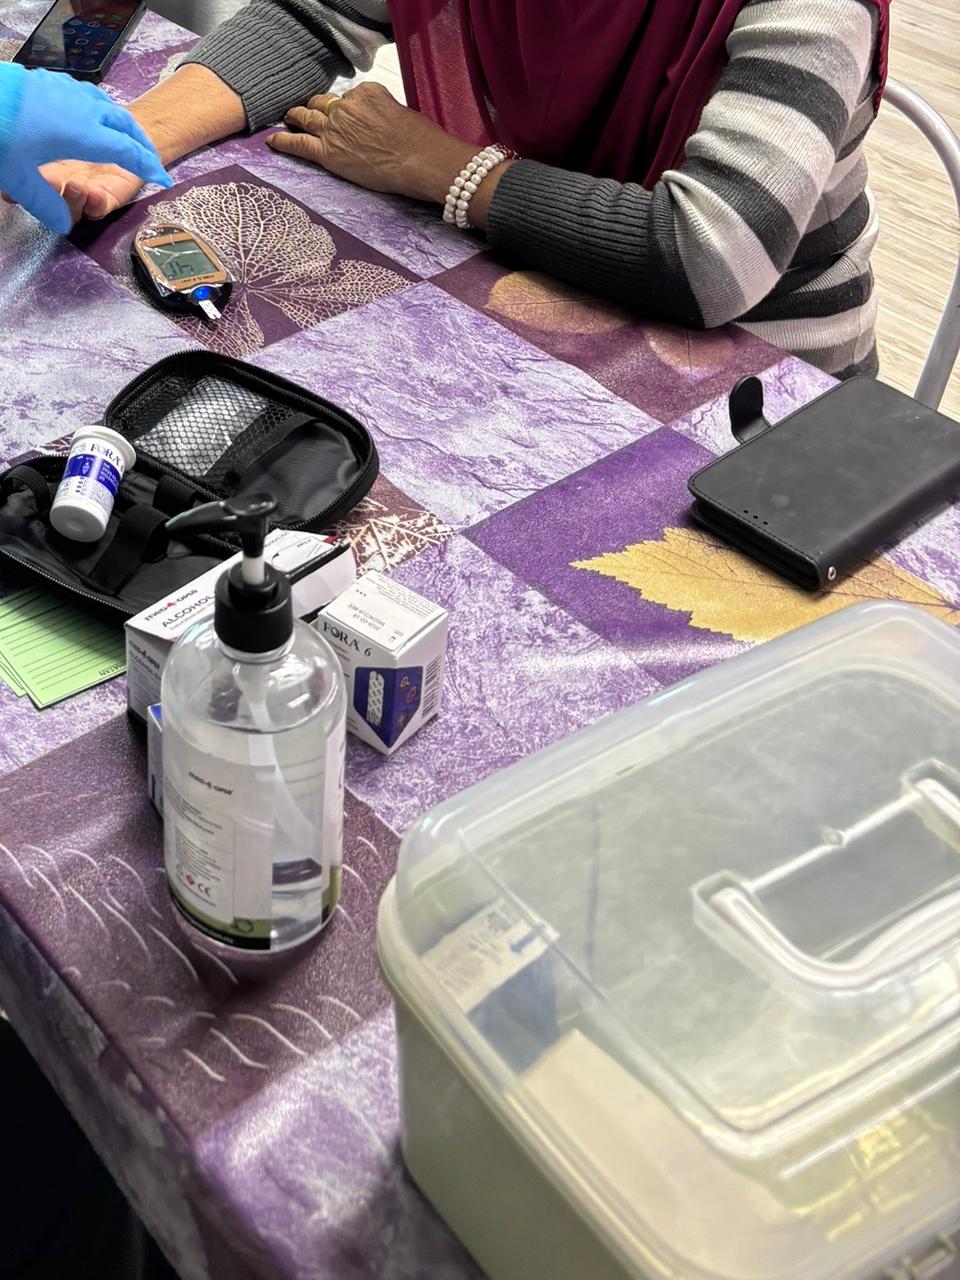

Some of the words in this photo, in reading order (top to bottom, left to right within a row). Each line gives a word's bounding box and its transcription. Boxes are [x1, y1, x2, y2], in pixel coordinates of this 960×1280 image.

[90, 443, 122, 467] FORA
[161, 594, 215, 628] ALCOHOL
[322, 622, 361, 652] FORA
[364, 647, 372, 658] 6
